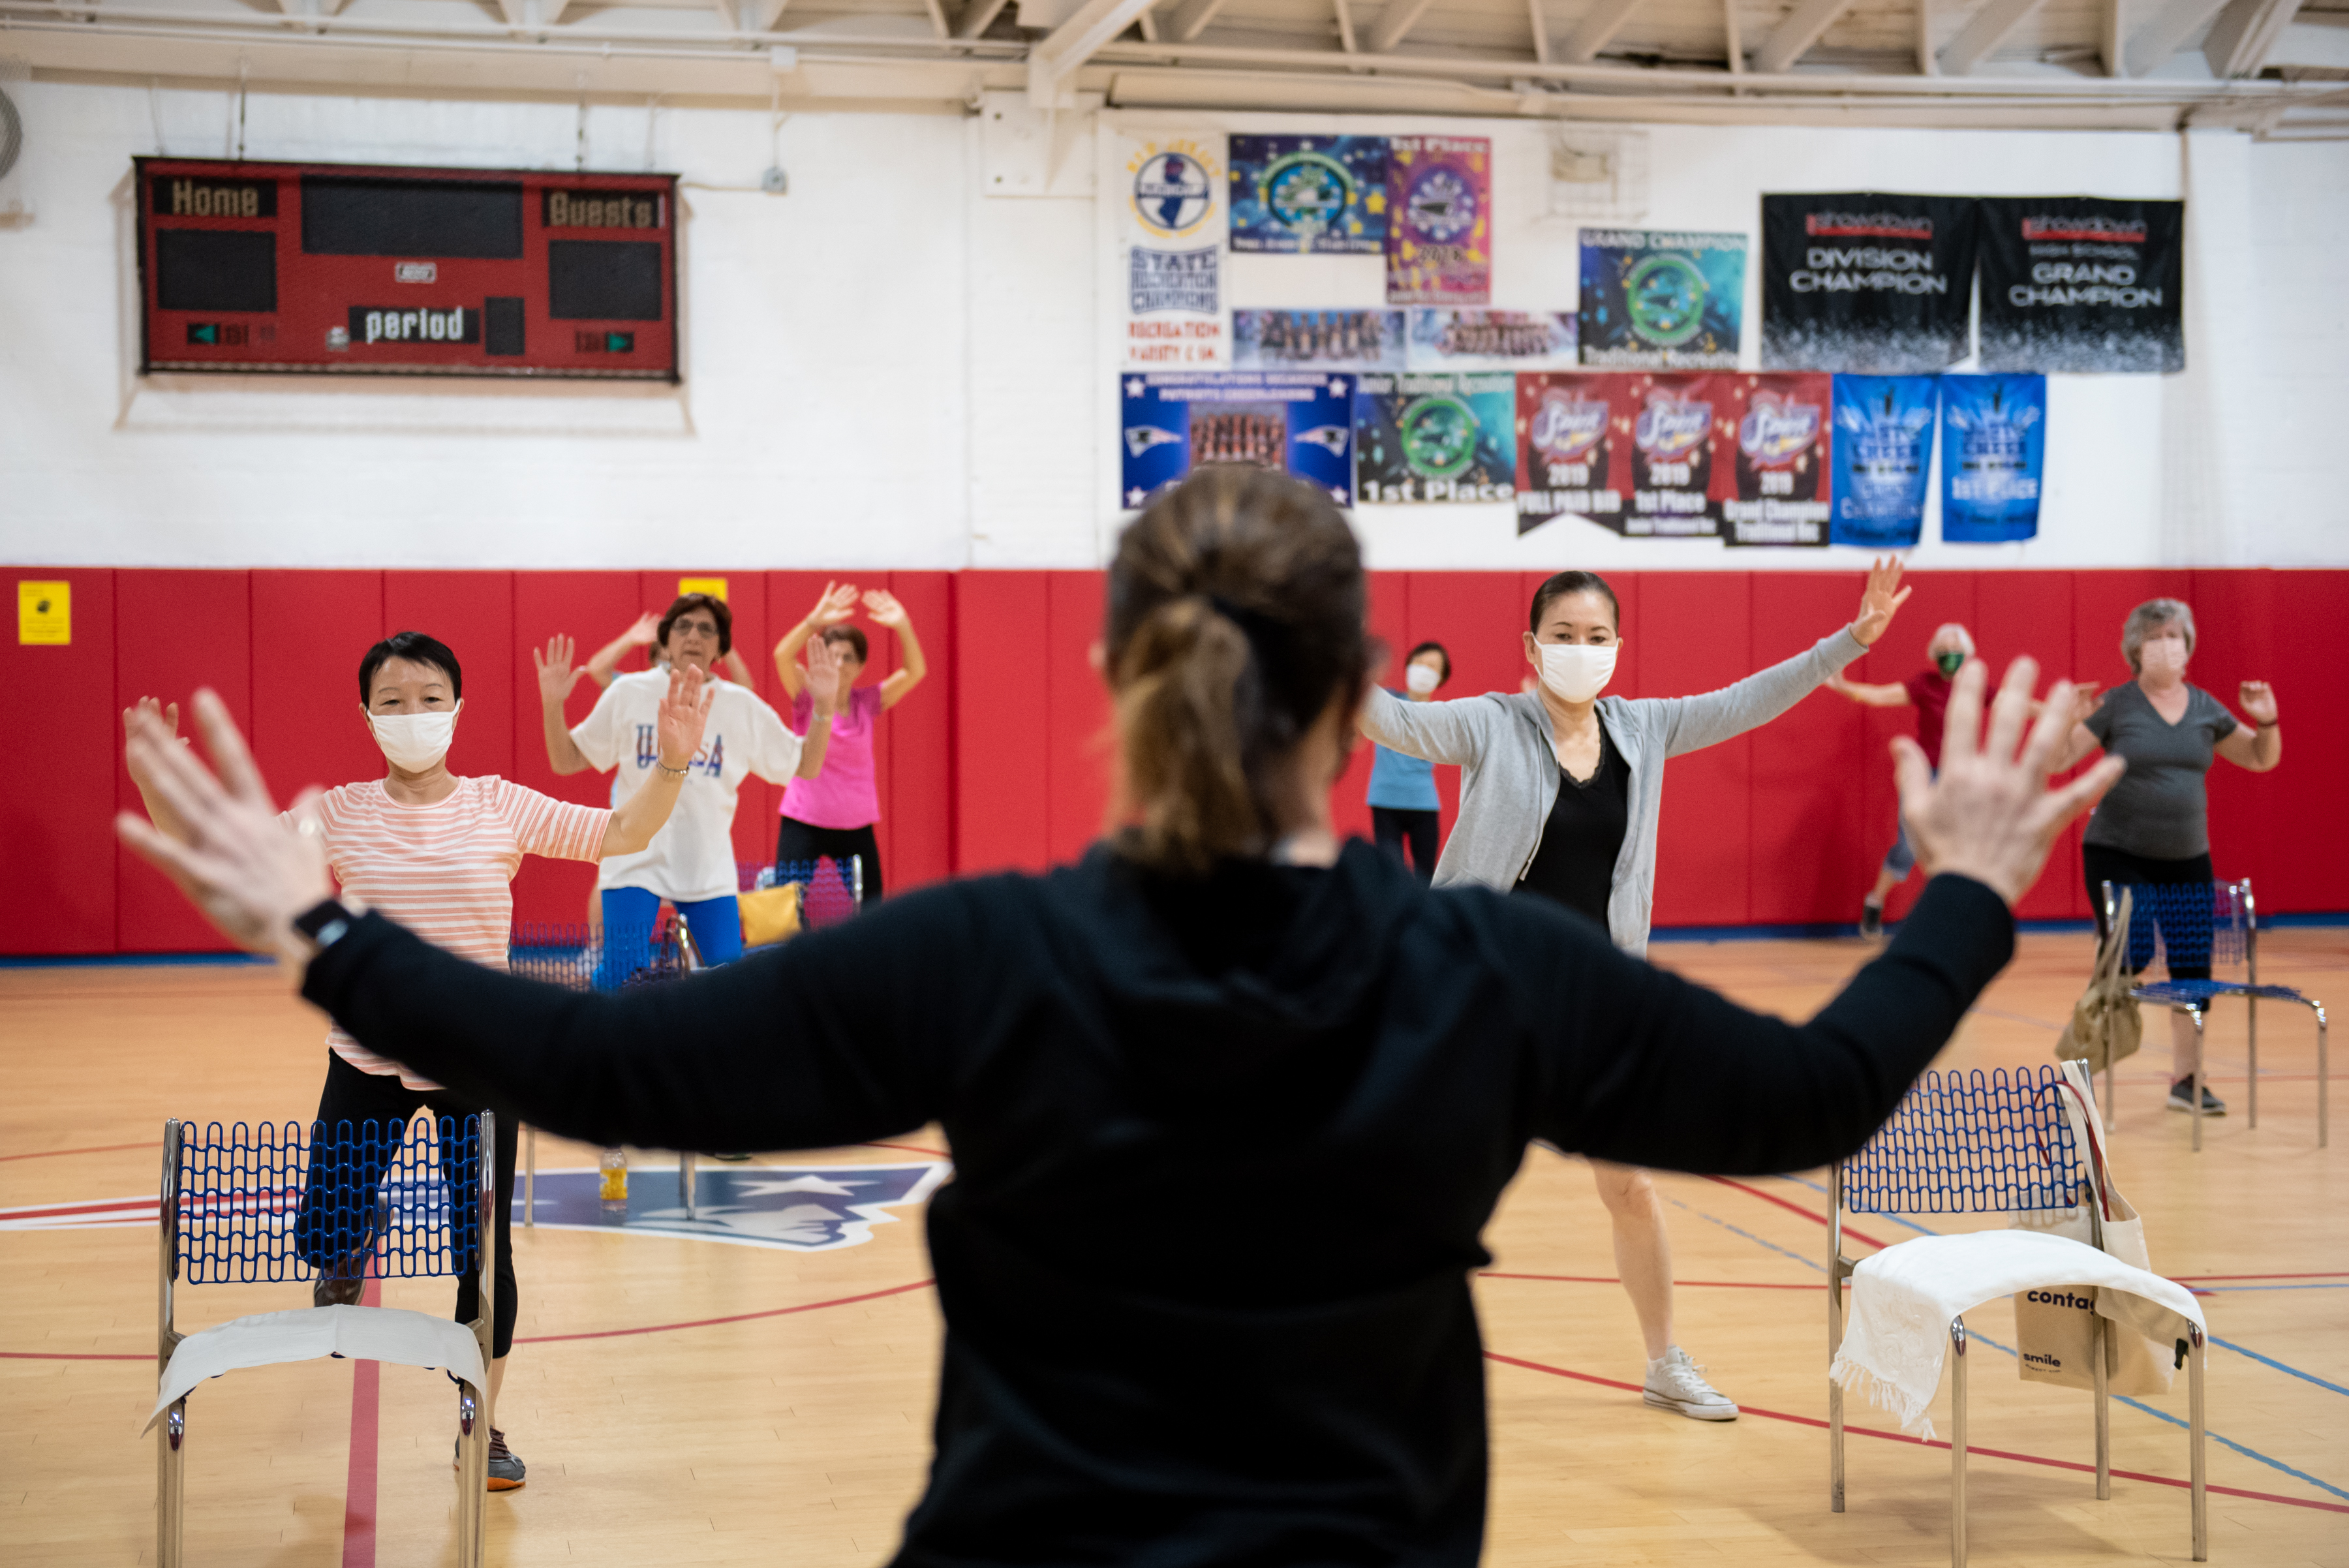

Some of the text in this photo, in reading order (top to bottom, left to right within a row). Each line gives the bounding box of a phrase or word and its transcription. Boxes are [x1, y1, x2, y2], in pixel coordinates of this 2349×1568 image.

[172, 179, 258, 216] Home
[549, 192, 652, 227] Guests
[1807, 247, 1933, 271] DIVISION
[1789, 269, 1948, 295] CHAMPION
[2031, 262, 2136, 286] GRAND
[2008, 284, 2162, 308] CHAMPION
[366, 305, 463, 345] period
[1129, 322, 1220, 339] RECREATION
[1549, 463, 1590, 487] 2019
[1650, 462, 1691, 486] 2019
[1760, 471, 1794, 495] 2019
[1362, 479, 1514, 502] 1st Place
[1518, 490, 1552, 514] FULL
[1554, 490, 1590, 514] PAID
[1635, 489, 1707, 512] 1st Place
[2023, 1353, 2061, 1367] smile
